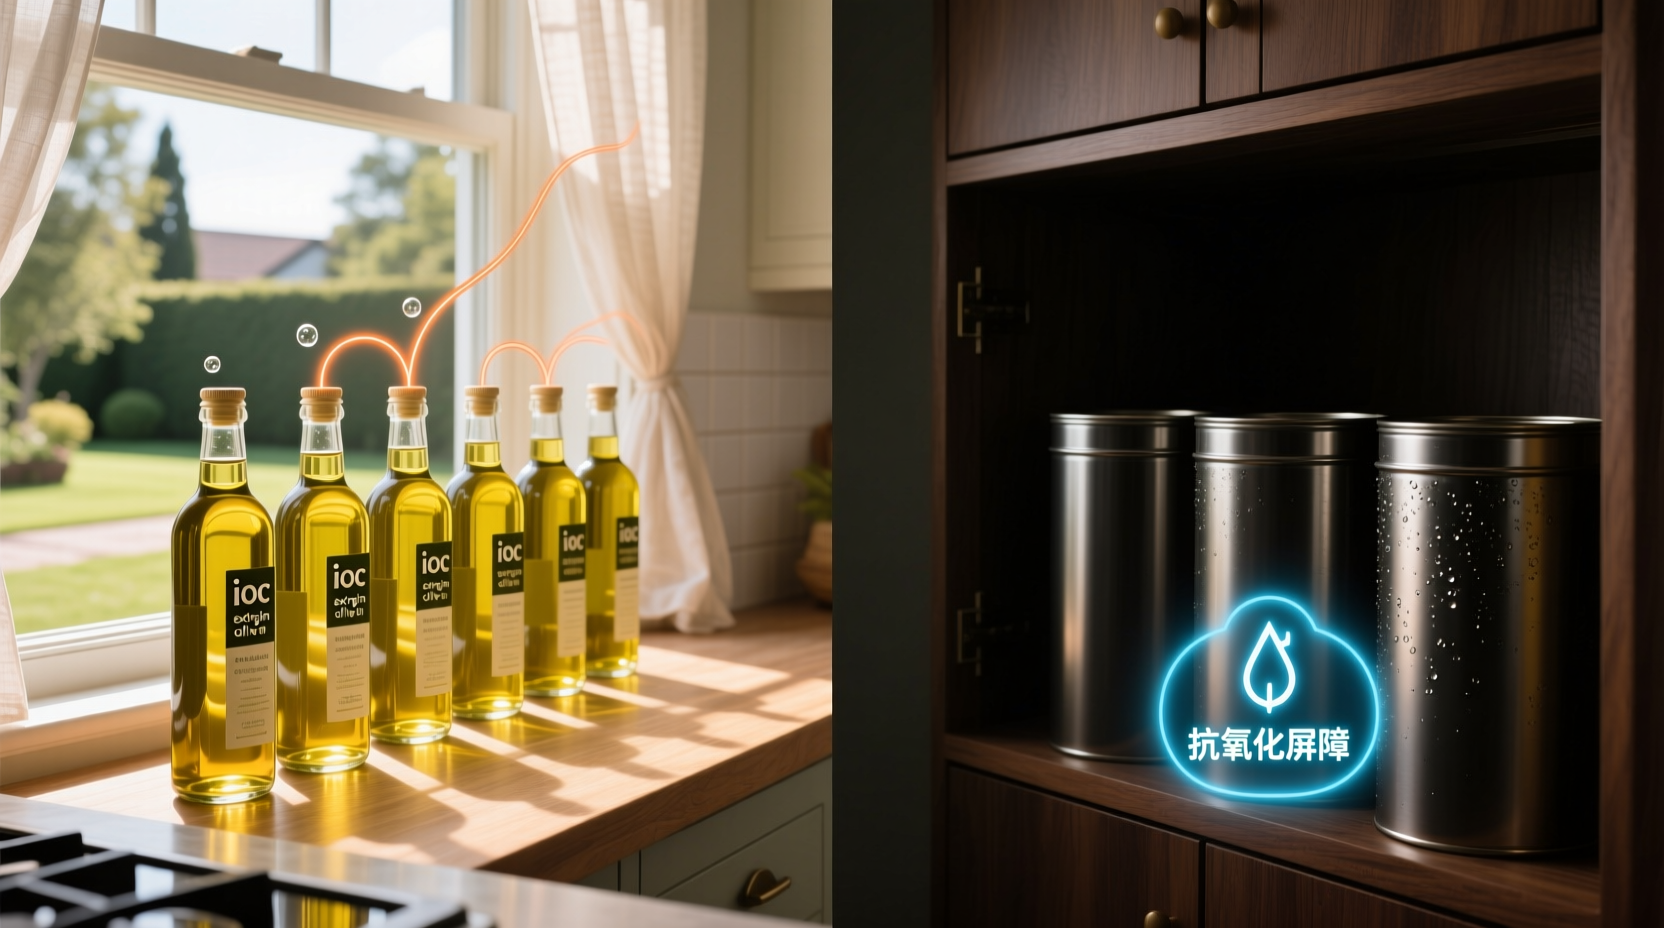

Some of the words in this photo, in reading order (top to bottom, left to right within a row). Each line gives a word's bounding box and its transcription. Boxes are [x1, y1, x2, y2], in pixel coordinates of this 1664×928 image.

[498, 540, 523, 563] ioc
[563, 530, 585, 552] ioc
[421, 550, 450, 574] ioc
[333, 563, 366, 589] ioc
[233, 578, 271, 606] ioc
